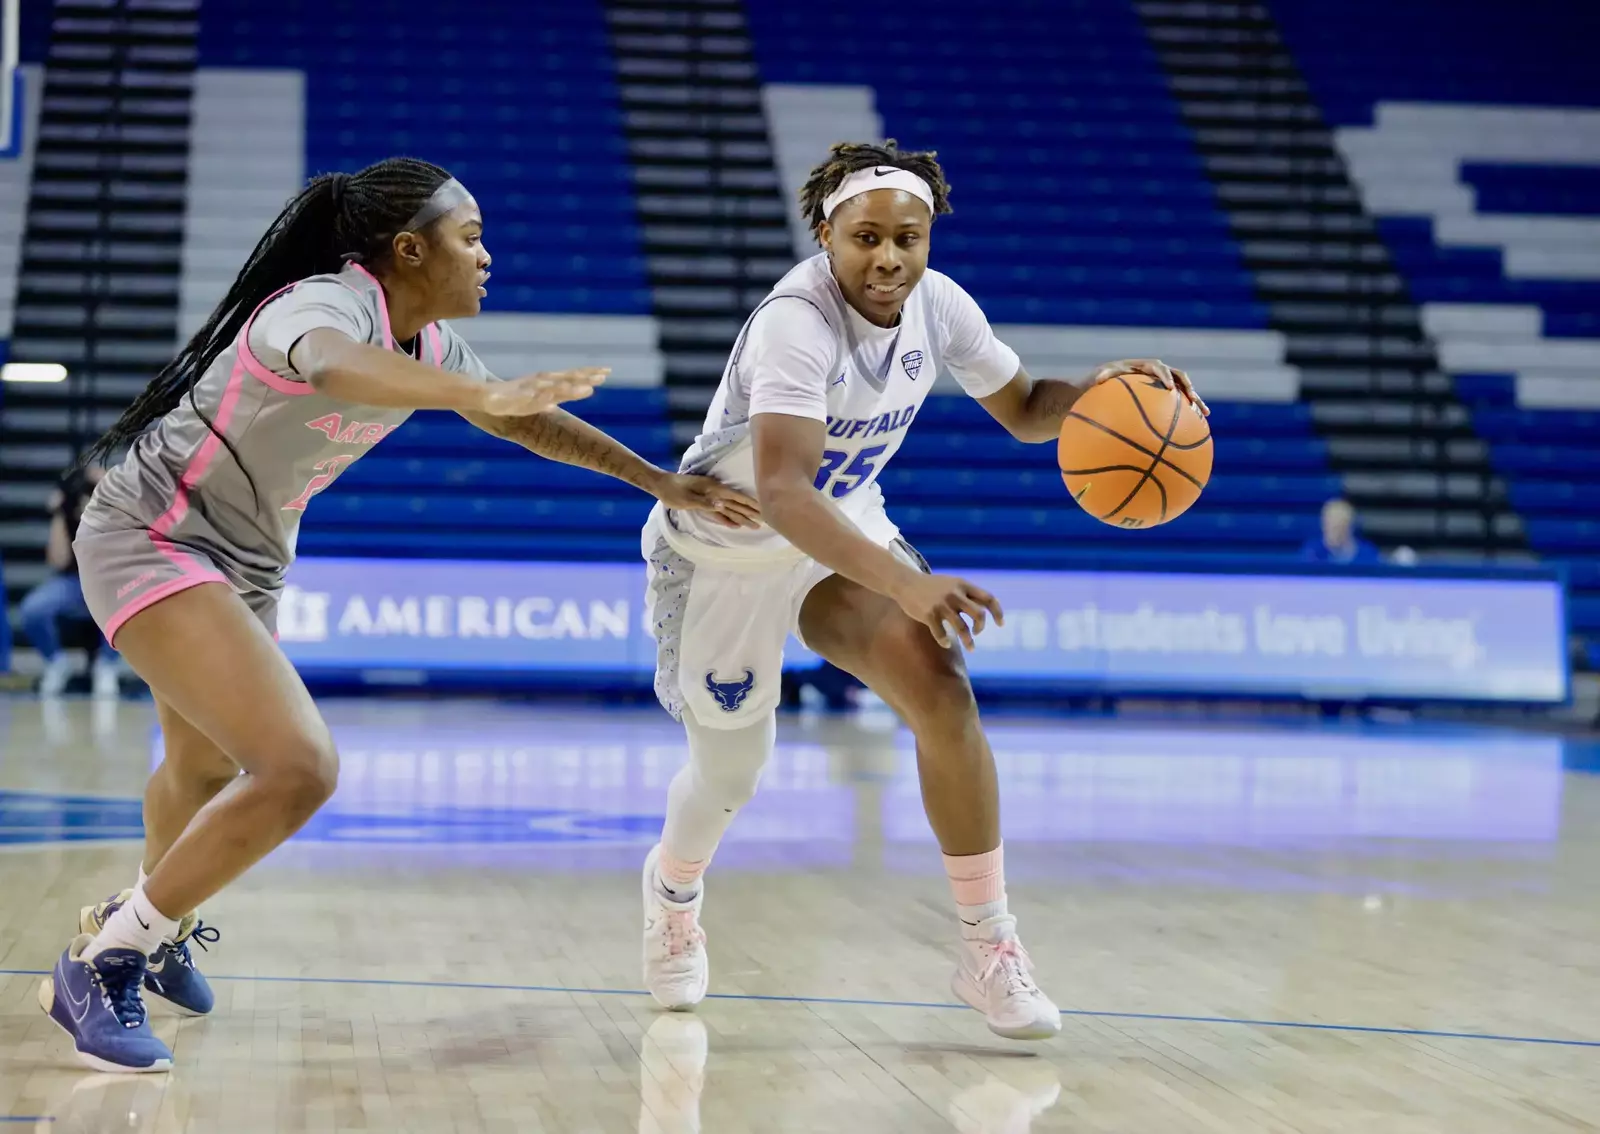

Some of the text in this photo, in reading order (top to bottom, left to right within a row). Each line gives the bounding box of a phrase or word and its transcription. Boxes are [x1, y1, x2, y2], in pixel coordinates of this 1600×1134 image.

[813, 443, 888, 498] 35
[338, 596, 630, 639] AMERICAN
[1057, 602, 1246, 655] students
[1254, 605, 1345, 656] love
